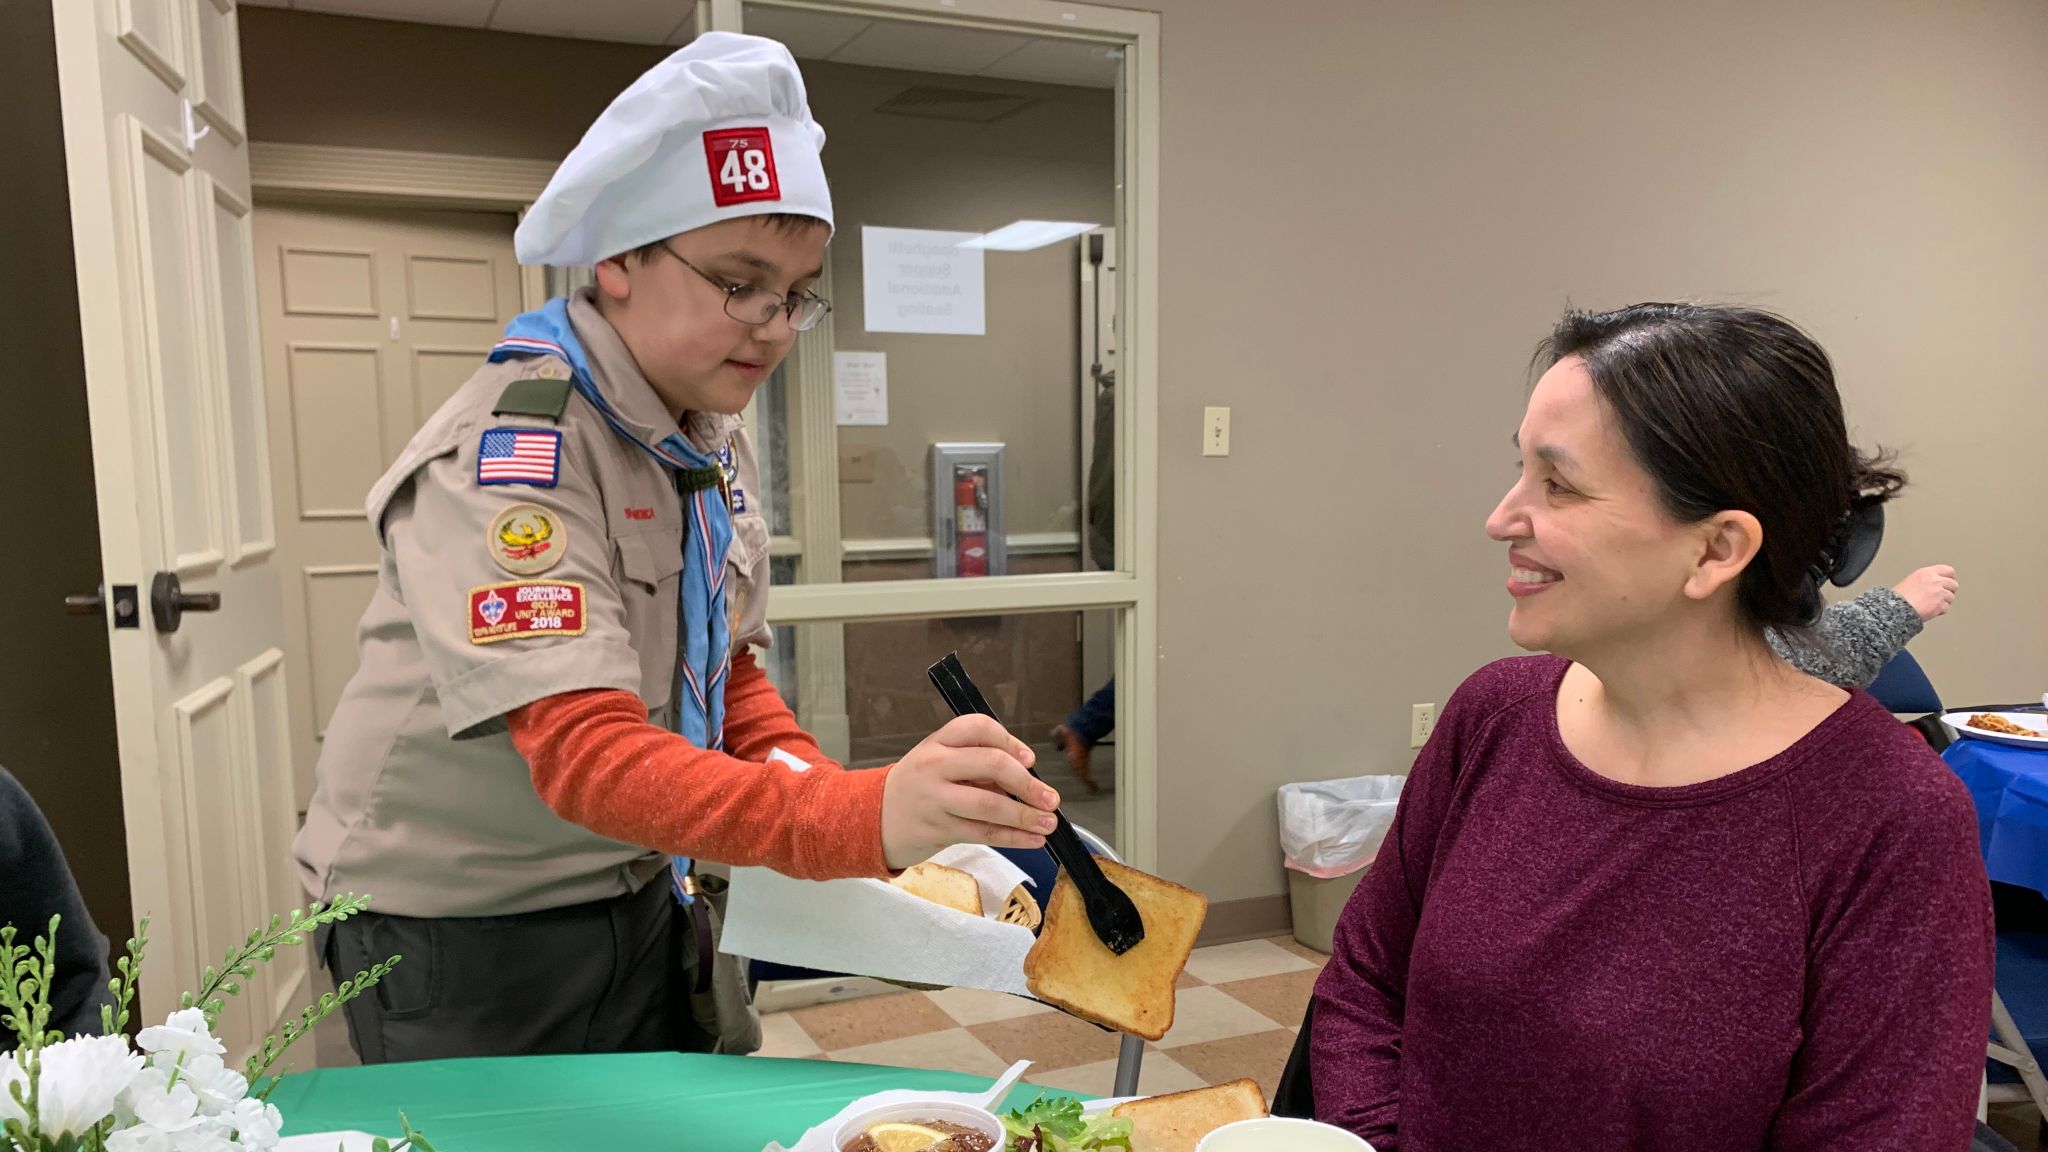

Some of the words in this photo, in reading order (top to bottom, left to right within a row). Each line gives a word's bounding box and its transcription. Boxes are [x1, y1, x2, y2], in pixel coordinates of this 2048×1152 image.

[728, 138, 749, 148] 75
[720, 149, 770, 193] 48
[518, 586, 558, 595] JOURNEY
[516, 592, 573, 602] EXCELLENCE
[531, 601, 558, 609] GOLD
[515, 610, 537, 619] UNIT
[539, 609, 575, 618] AWARD
[530, 617, 562, 629] 2018
